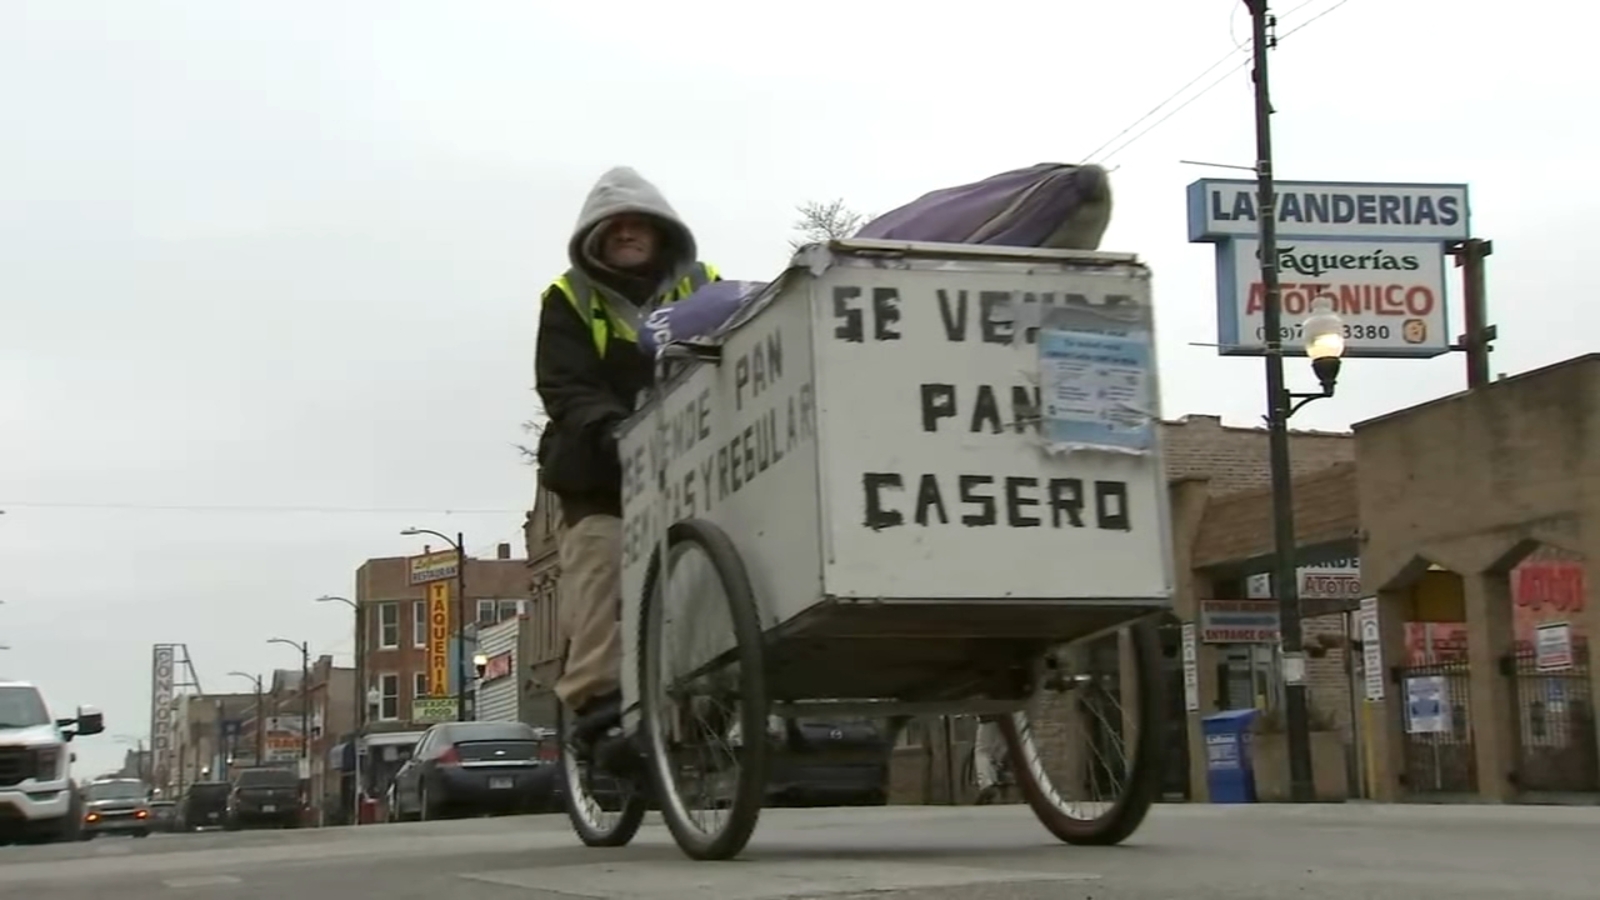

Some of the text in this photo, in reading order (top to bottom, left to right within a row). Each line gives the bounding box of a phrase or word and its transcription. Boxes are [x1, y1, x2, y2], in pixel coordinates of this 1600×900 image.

[832, 286, 902, 343] SE
[736, 326, 782, 412] PAN
[920, 383, 1041, 434] PAN
[861, 472, 1131, 532] CASERO
[412, 567, 456, 581] RESTAURAN
[433, 585, 446, 695] TAQUERIA
